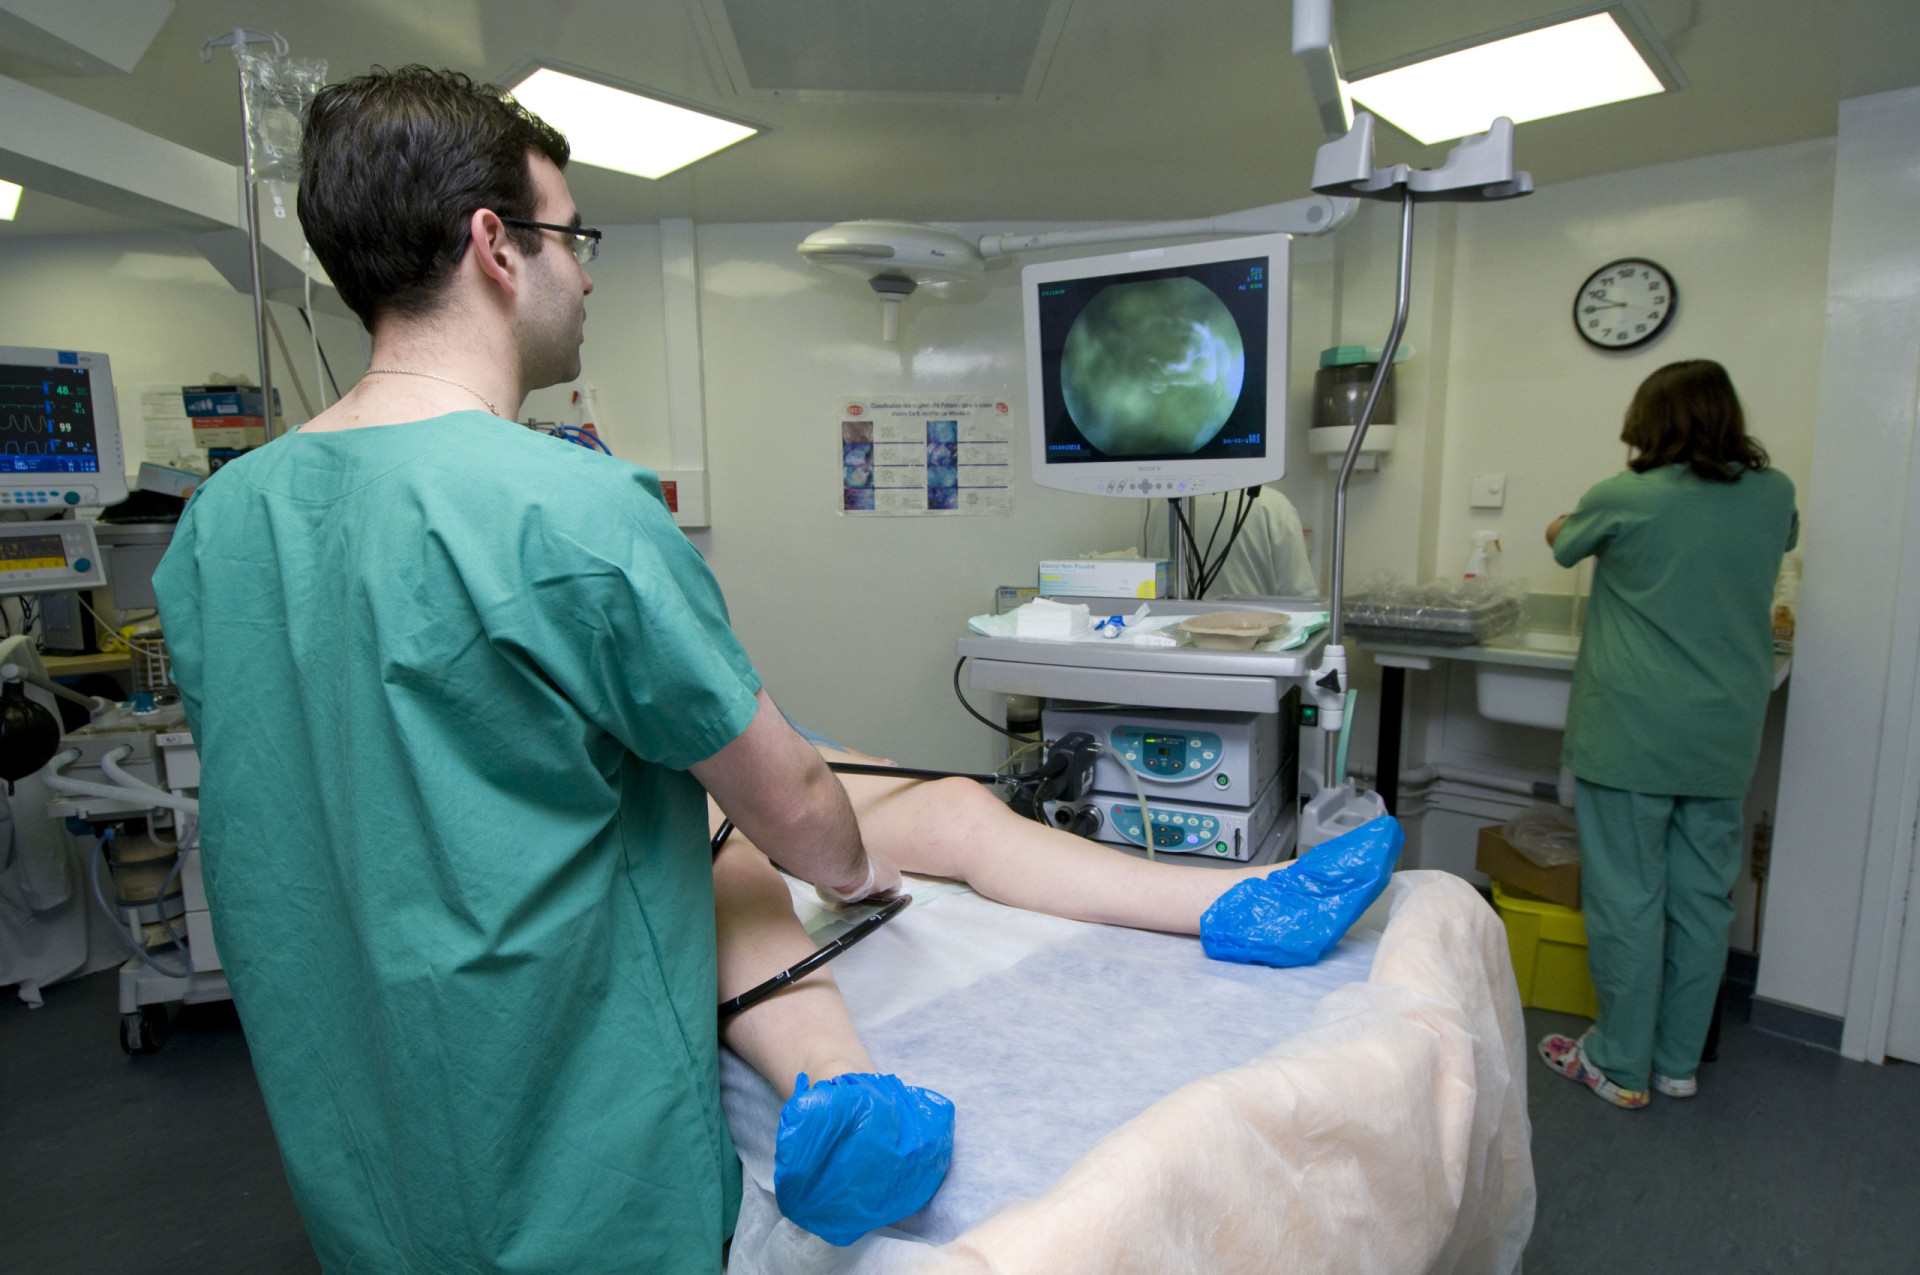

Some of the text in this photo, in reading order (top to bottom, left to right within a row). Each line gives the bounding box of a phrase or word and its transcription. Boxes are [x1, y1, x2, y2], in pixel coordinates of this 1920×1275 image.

[1618, 268, 1635, 278] 12
[1641, 271, 1650, 280] 1
[1600, 277, 1614, 286] 11
[1648, 281, 1661, 291] 2
[1588, 289, 1607, 299] 10
[1653, 295, 1665, 305] 3
[1647, 311, 1659, 319] 4
[1602, 328, 1612, 337] 7
[1635, 323, 1647, 333] 5
[1616, 331, 1628, 340] 6
[57, 385, 69, 395] 48
[59, 422, 72, 433] 99
